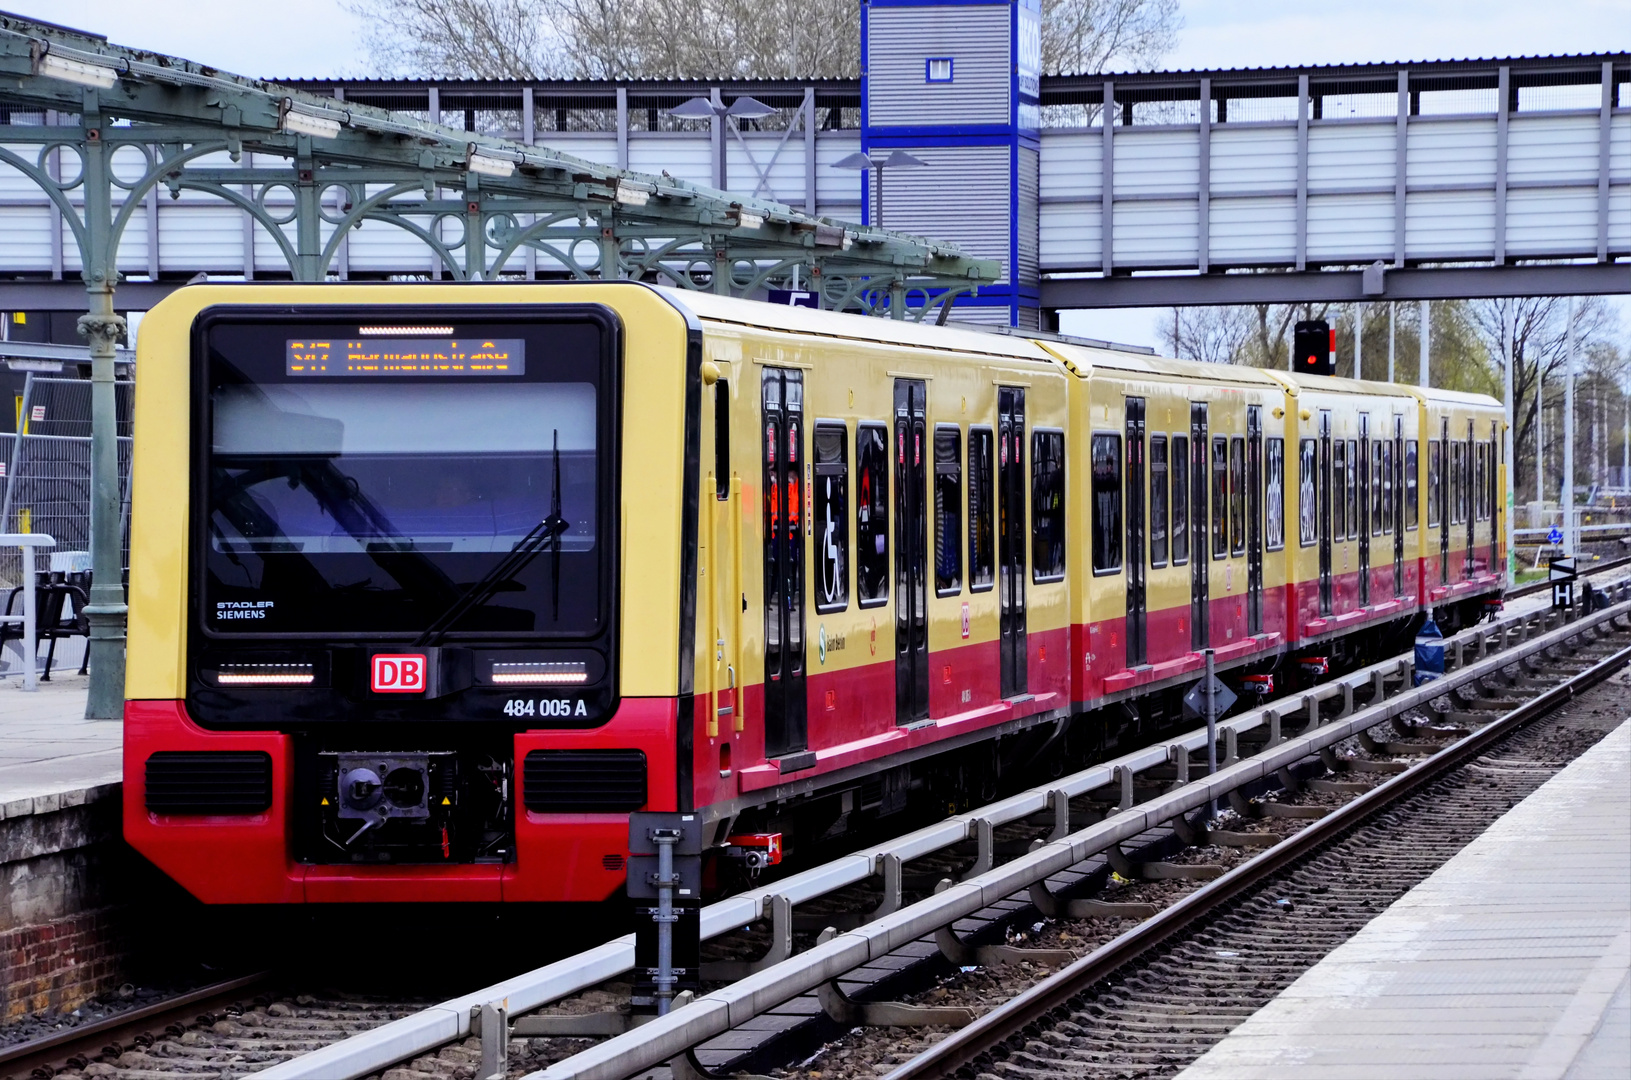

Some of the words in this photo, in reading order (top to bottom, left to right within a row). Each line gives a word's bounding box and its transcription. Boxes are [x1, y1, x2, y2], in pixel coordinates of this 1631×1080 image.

[1555, 584, 1570, 605] H
[216, 601, 274, 609] STADLER
[216, 610, 266, 620] SIEMENS
[378, 660, 420, 687] DB
[503, 699, 535, 717] 484
[539, 699, 571, 717] 005
[574, 699, 588, 717] A
